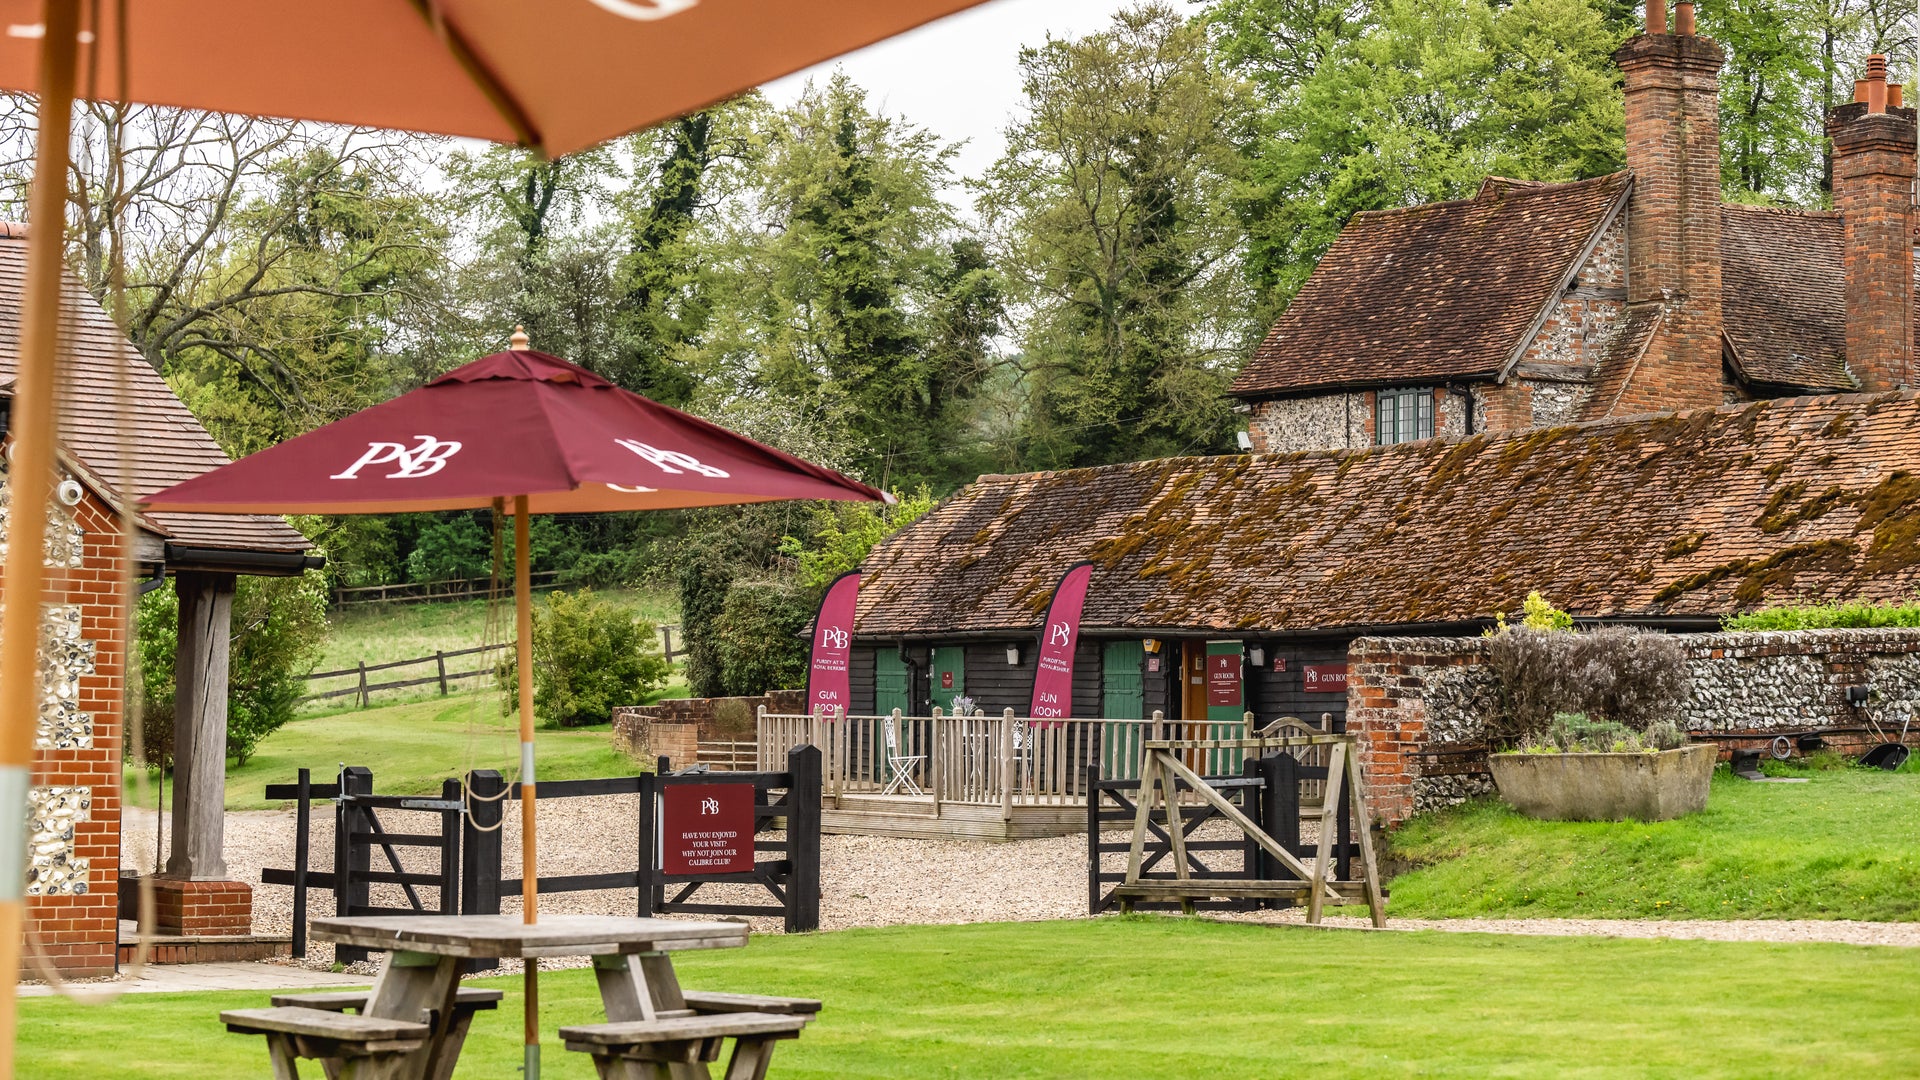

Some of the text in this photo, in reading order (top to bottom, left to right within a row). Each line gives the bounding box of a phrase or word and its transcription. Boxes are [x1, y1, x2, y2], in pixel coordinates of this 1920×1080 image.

[1321, 673, 1348, 682] GUN ROO
[819, 691, 837, 699] GUN
[698, 831, 711, 839] YOU
[711, 831, 737, 840] ENJOYED
[692, 840, 728, 848] YOUR VISIT?
[697, 849, 710, 857] NOT
[709, 849, 724, 858] JOIN
[688, 858, 713, 866] CALIBRE
